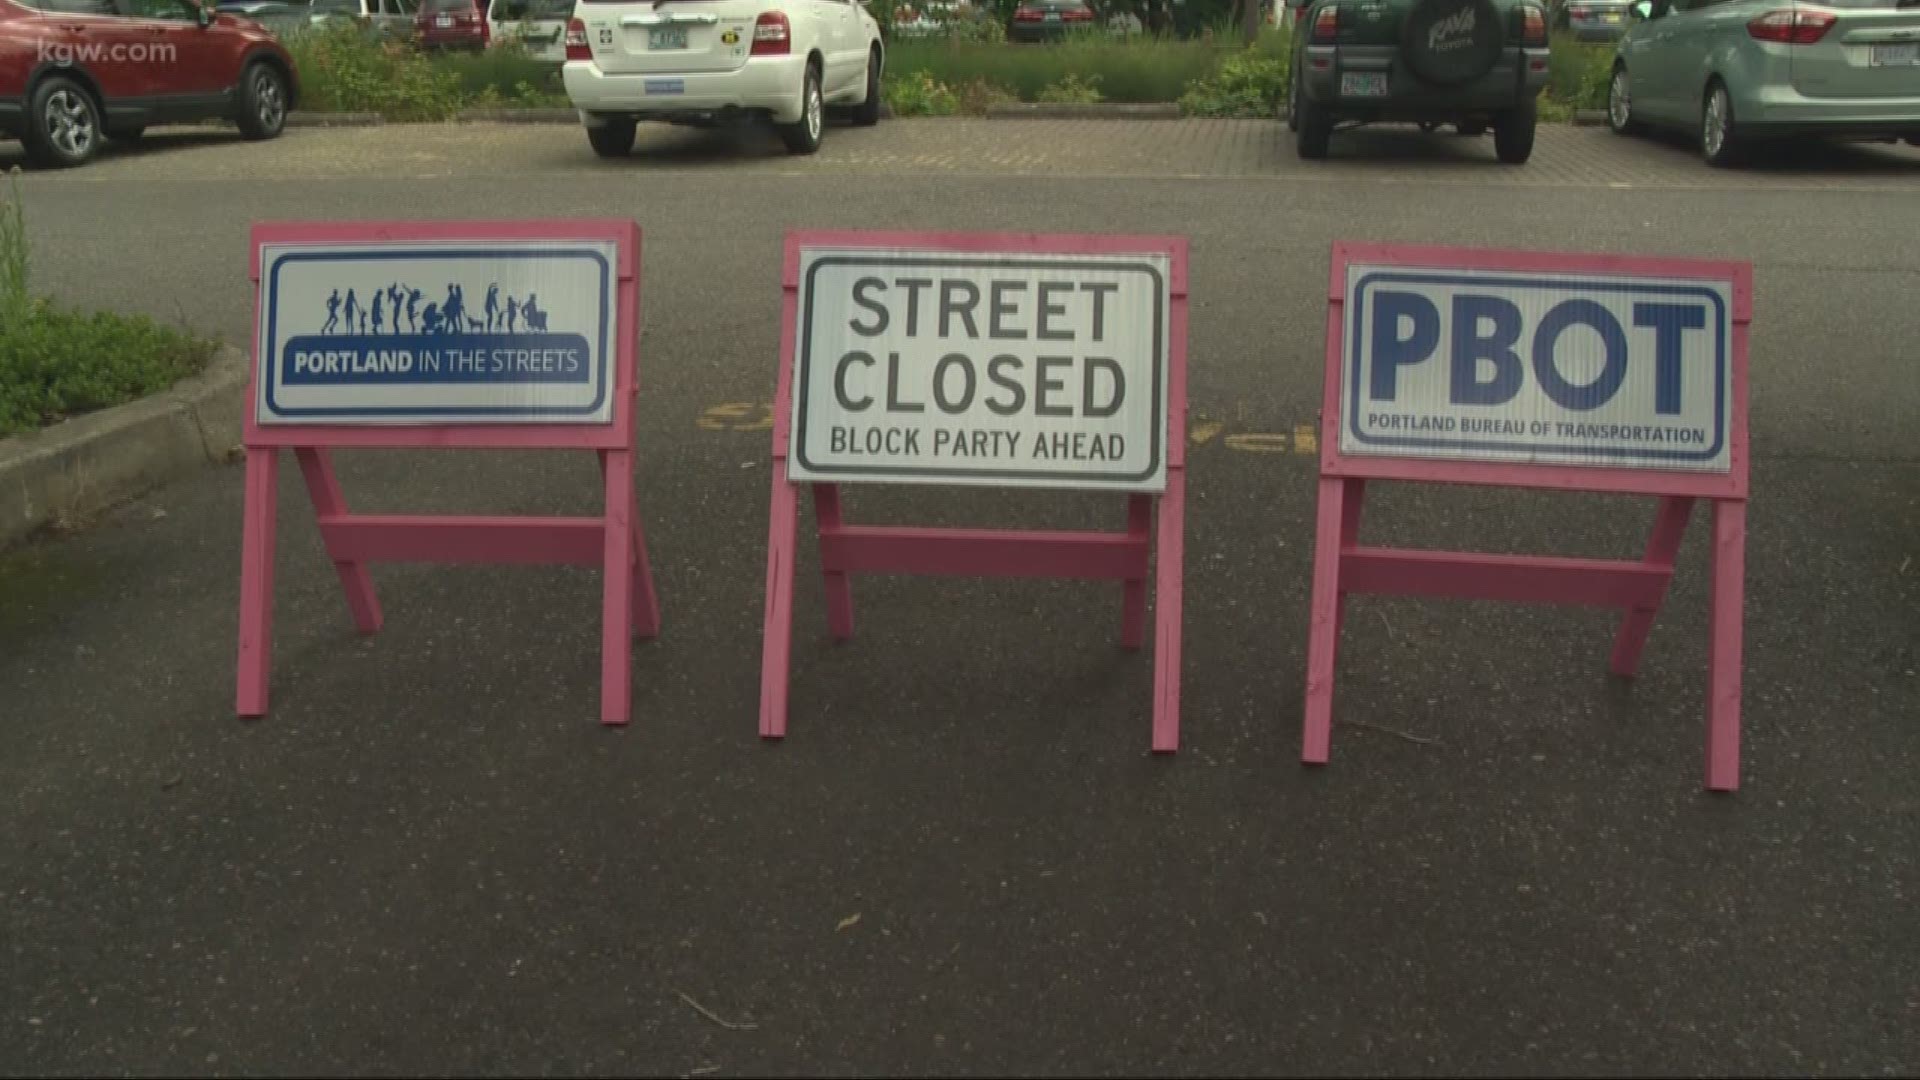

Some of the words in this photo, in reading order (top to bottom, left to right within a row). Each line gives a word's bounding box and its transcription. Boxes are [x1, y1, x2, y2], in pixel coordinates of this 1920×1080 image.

[848, 276, 1119, 342] STREET
[295, 351, 412, 373] PORTLAND
[418, 350, 440, 373] IN
[445, 349, 486, 373] THE
[491, 348, 579, 373] STREETS
[1370, 290, 1706, 415] PBOT
[833, 350, 1126, 418] CLOSED
[830, 425, 921, 456] BLOCK
[933, 429, 1021, 458] PARTY
[1032, 431, 1125, 462] AHEAD
[1367, 412, 1456, 433] PORTLAND
[1460, 417, 1526, 436] BUREAU
[1530, 420, 1551, 437] OF
[1556, 422, 1706, 445] TRANSPORTATION
